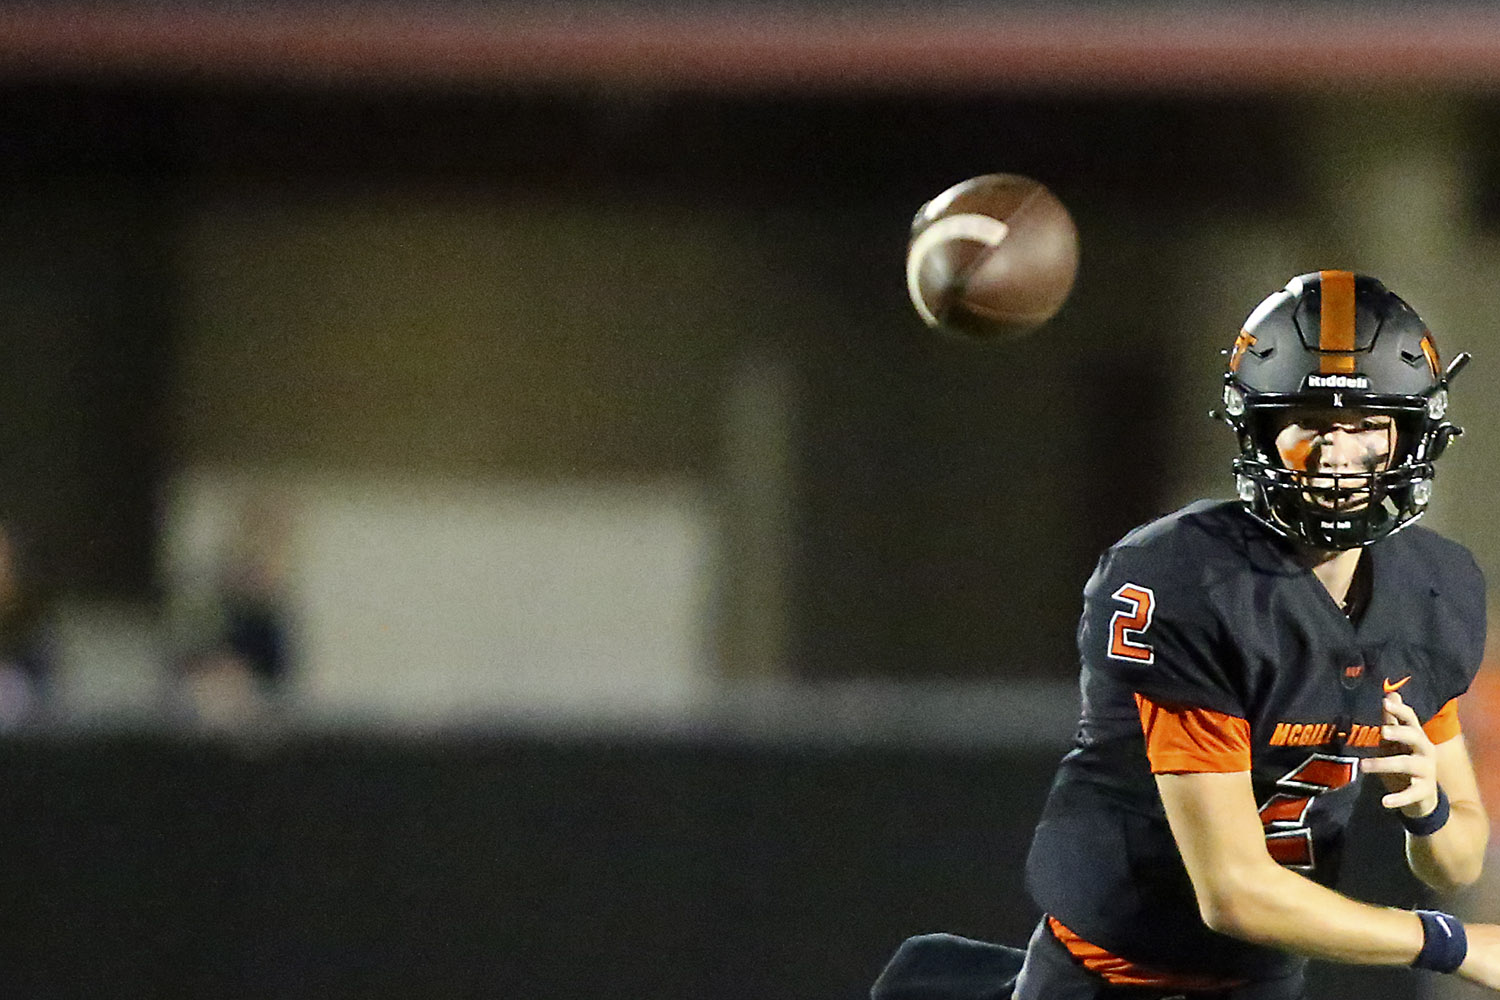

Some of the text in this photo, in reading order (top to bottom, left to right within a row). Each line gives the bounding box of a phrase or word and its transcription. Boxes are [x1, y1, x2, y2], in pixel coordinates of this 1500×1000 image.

[1308, 375, 1368, 388] Riddell
[1108, 583, 1155, 665] 2
[1258, 753, 1360, 870] 2
